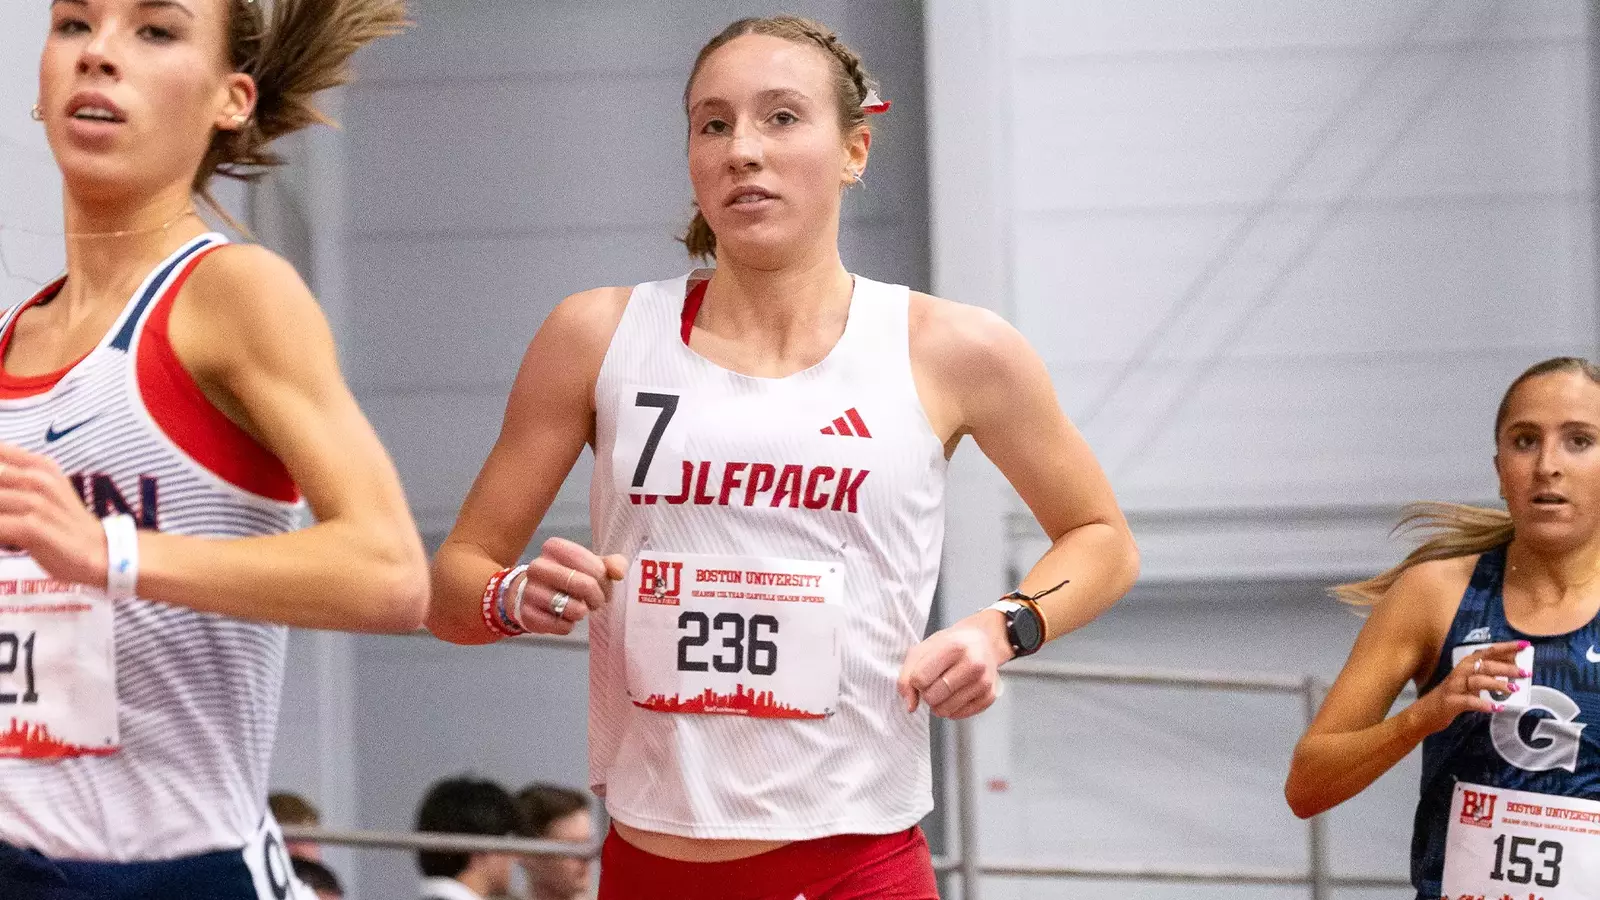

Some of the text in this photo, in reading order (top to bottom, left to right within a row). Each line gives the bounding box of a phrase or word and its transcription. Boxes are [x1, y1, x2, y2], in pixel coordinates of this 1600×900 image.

[631, 391, 680, 488] 7
[638, 559, 683, 597] BU
[695, 568, 822, 587] BOSTON UNIVERSITY
[676, 610, 779, 676] 236
[1460, 789, 1497, 821] BU
[1489, 833, 1563, 888] 153
